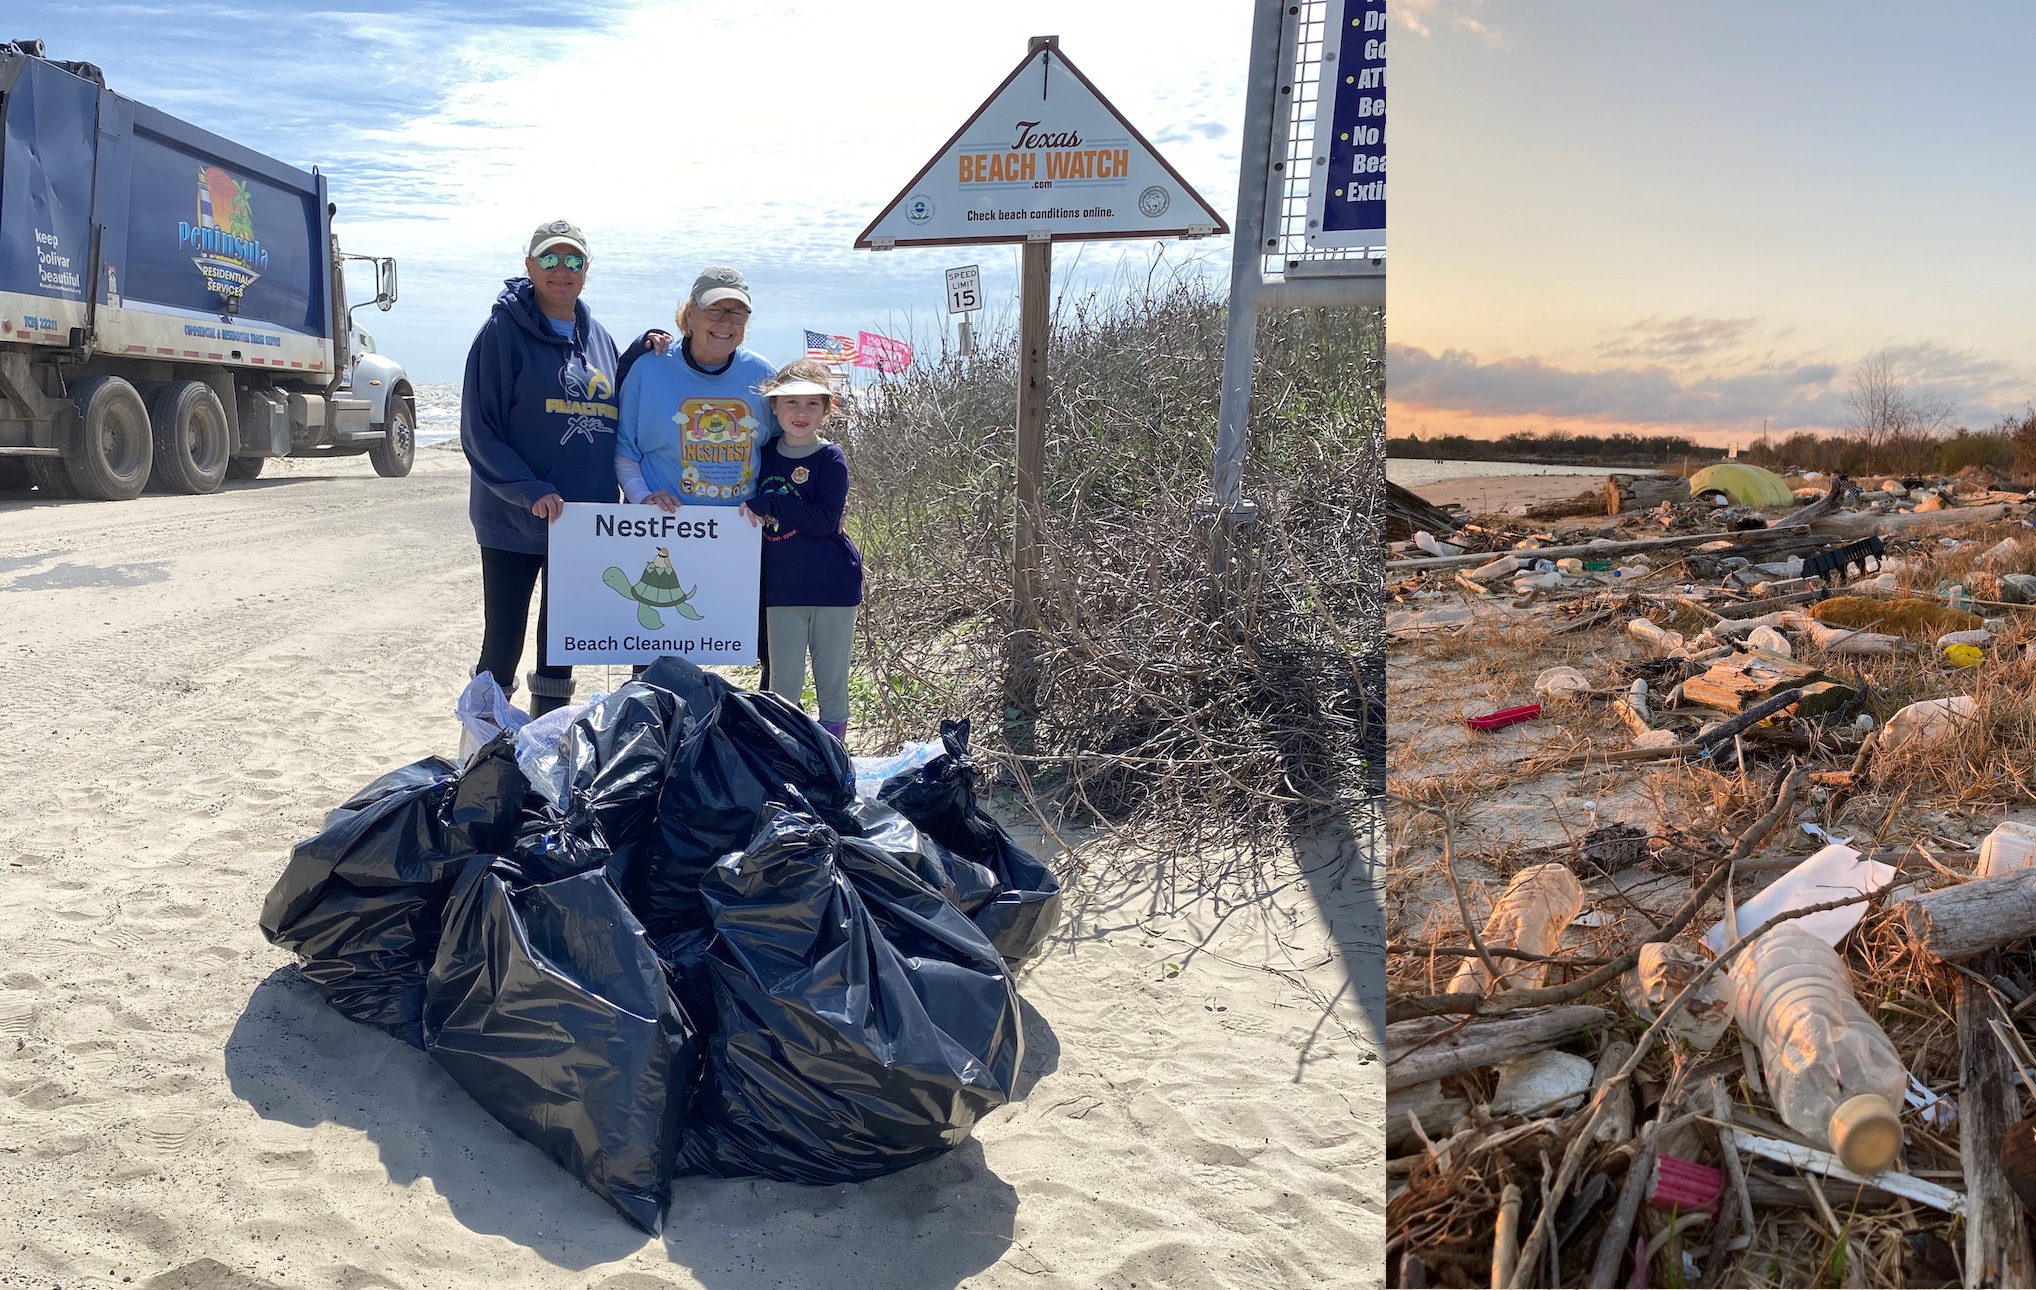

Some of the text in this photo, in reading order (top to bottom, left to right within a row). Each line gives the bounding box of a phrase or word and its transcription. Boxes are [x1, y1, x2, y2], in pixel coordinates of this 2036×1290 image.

[1358, 97, 1386, 117] Be
[1011, 120, 1082, 150] Texas
[1352, 125, 1380, 146] No
[959, 149, 1129, 183] BEACH WATCH
[1031, 181, 1052, 189] .com
[967, 206, 1115, 221] Check beach conditions online.
[34, 228, 59, 249] keep
[37, 246, 71, 268] bolivar
[38, 264, 80, 287] beautiful
[202, 265, 250, 286] RESIDENTIAL
[948, 269, 977, 281] SPEED
[952, 279, 974, 290] LIMIT
[207, 280, 244, 297] SERVICES
[953, 289, 976, 308] 15
[685, 443, 749, 463] NESTFEST
[595, 514, 718, 539] NestFest
[564, 636, 742, 654] Beach Cleanup Here
